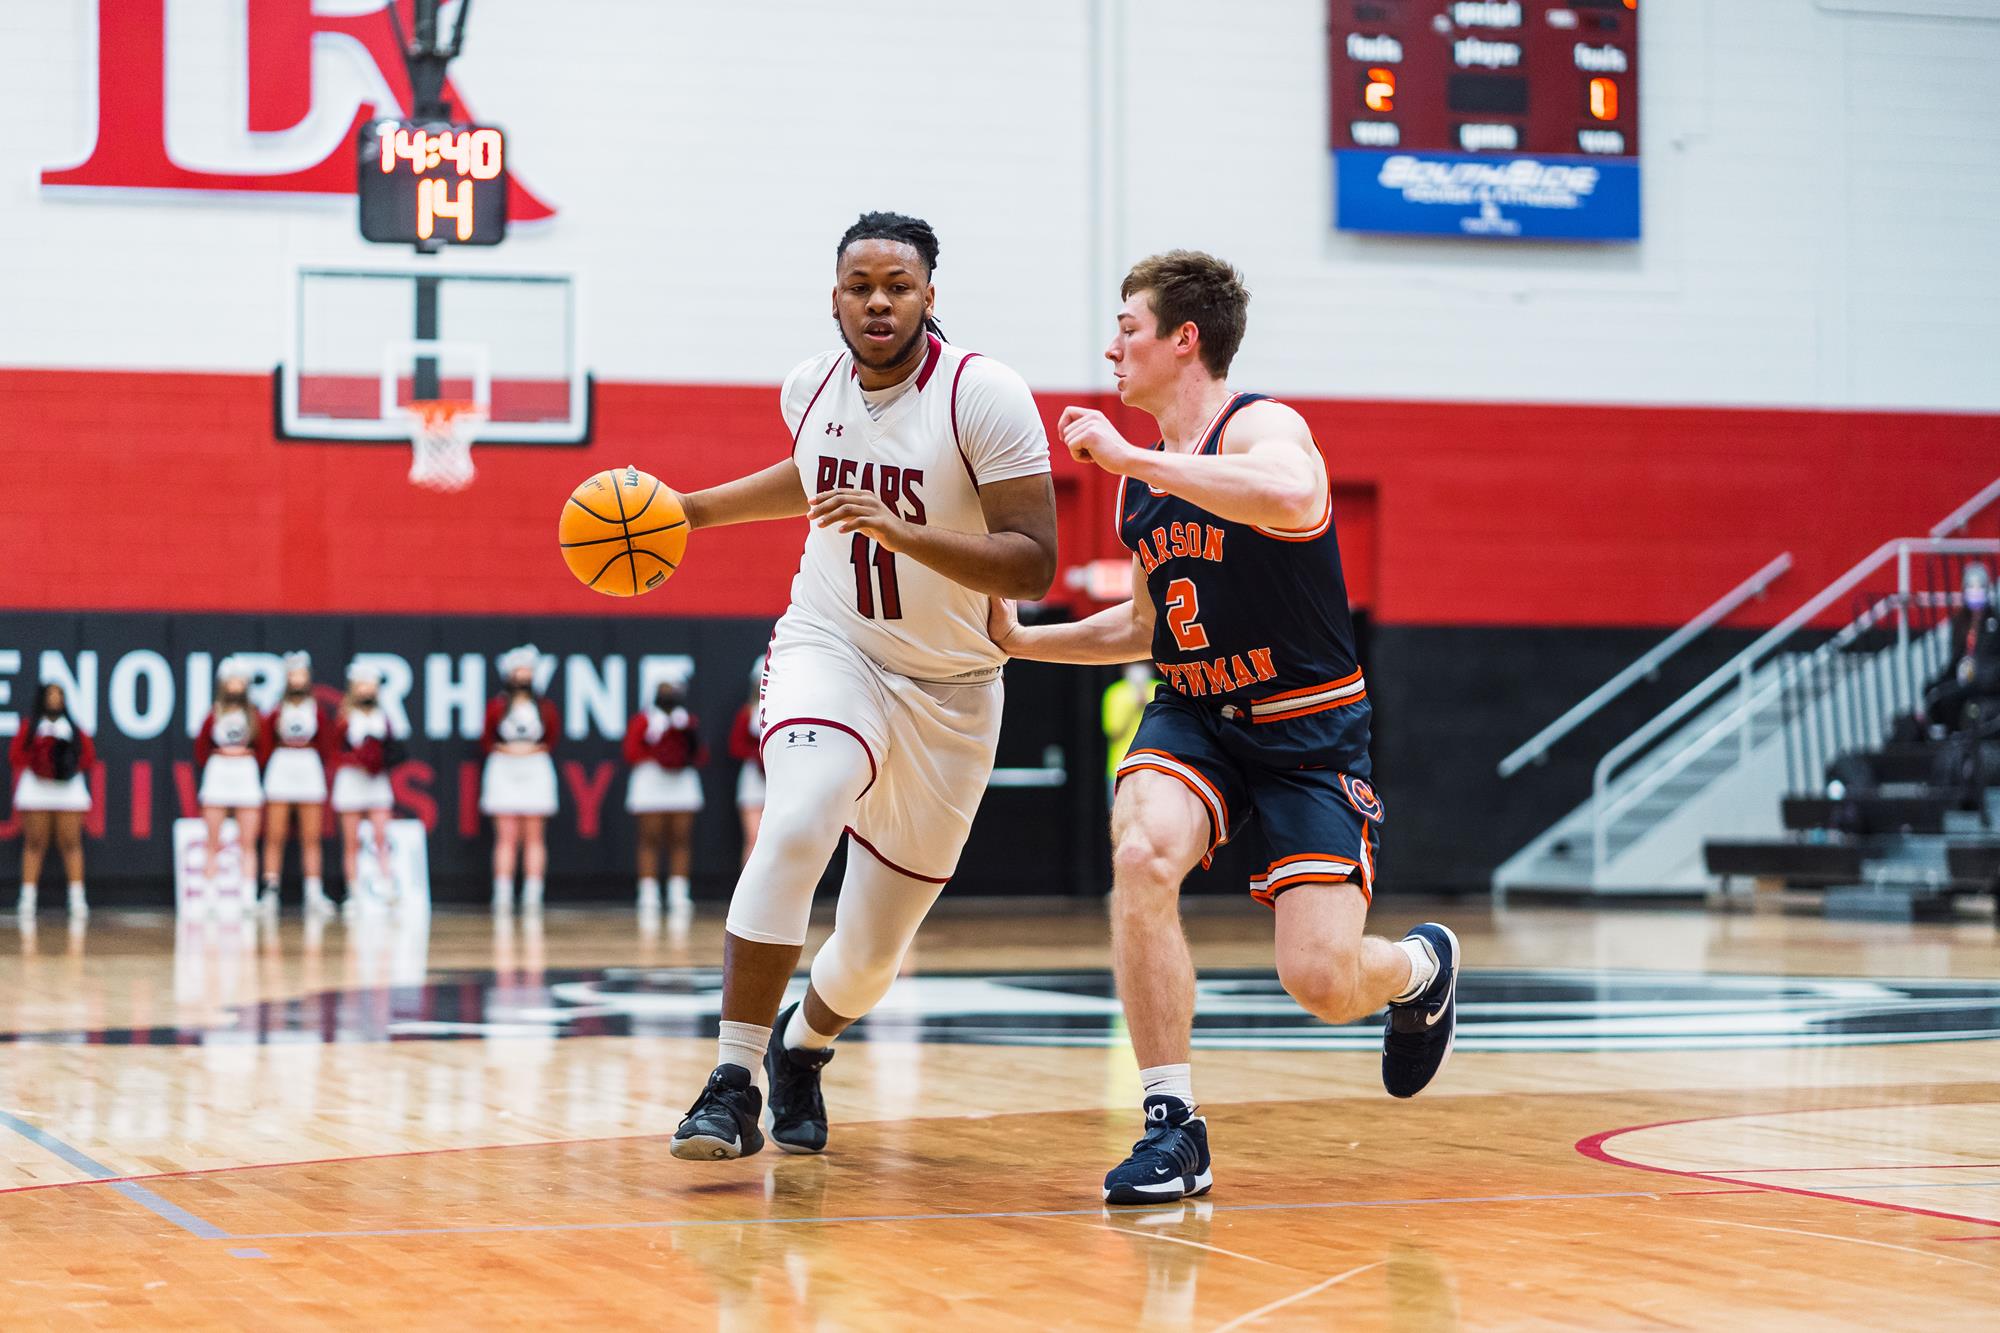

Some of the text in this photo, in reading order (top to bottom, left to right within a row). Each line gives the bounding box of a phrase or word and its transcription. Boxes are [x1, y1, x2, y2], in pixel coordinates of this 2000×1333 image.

[1365, 68, 1396, 111] 2
[380, 127, 501, 179] 14:40
[417, 178, 473, 240] 14
[850, 531, 903, 620] 11
[1136, 522, 1225, 576] ARSON
[1165, 577, 1210, 651] 2
